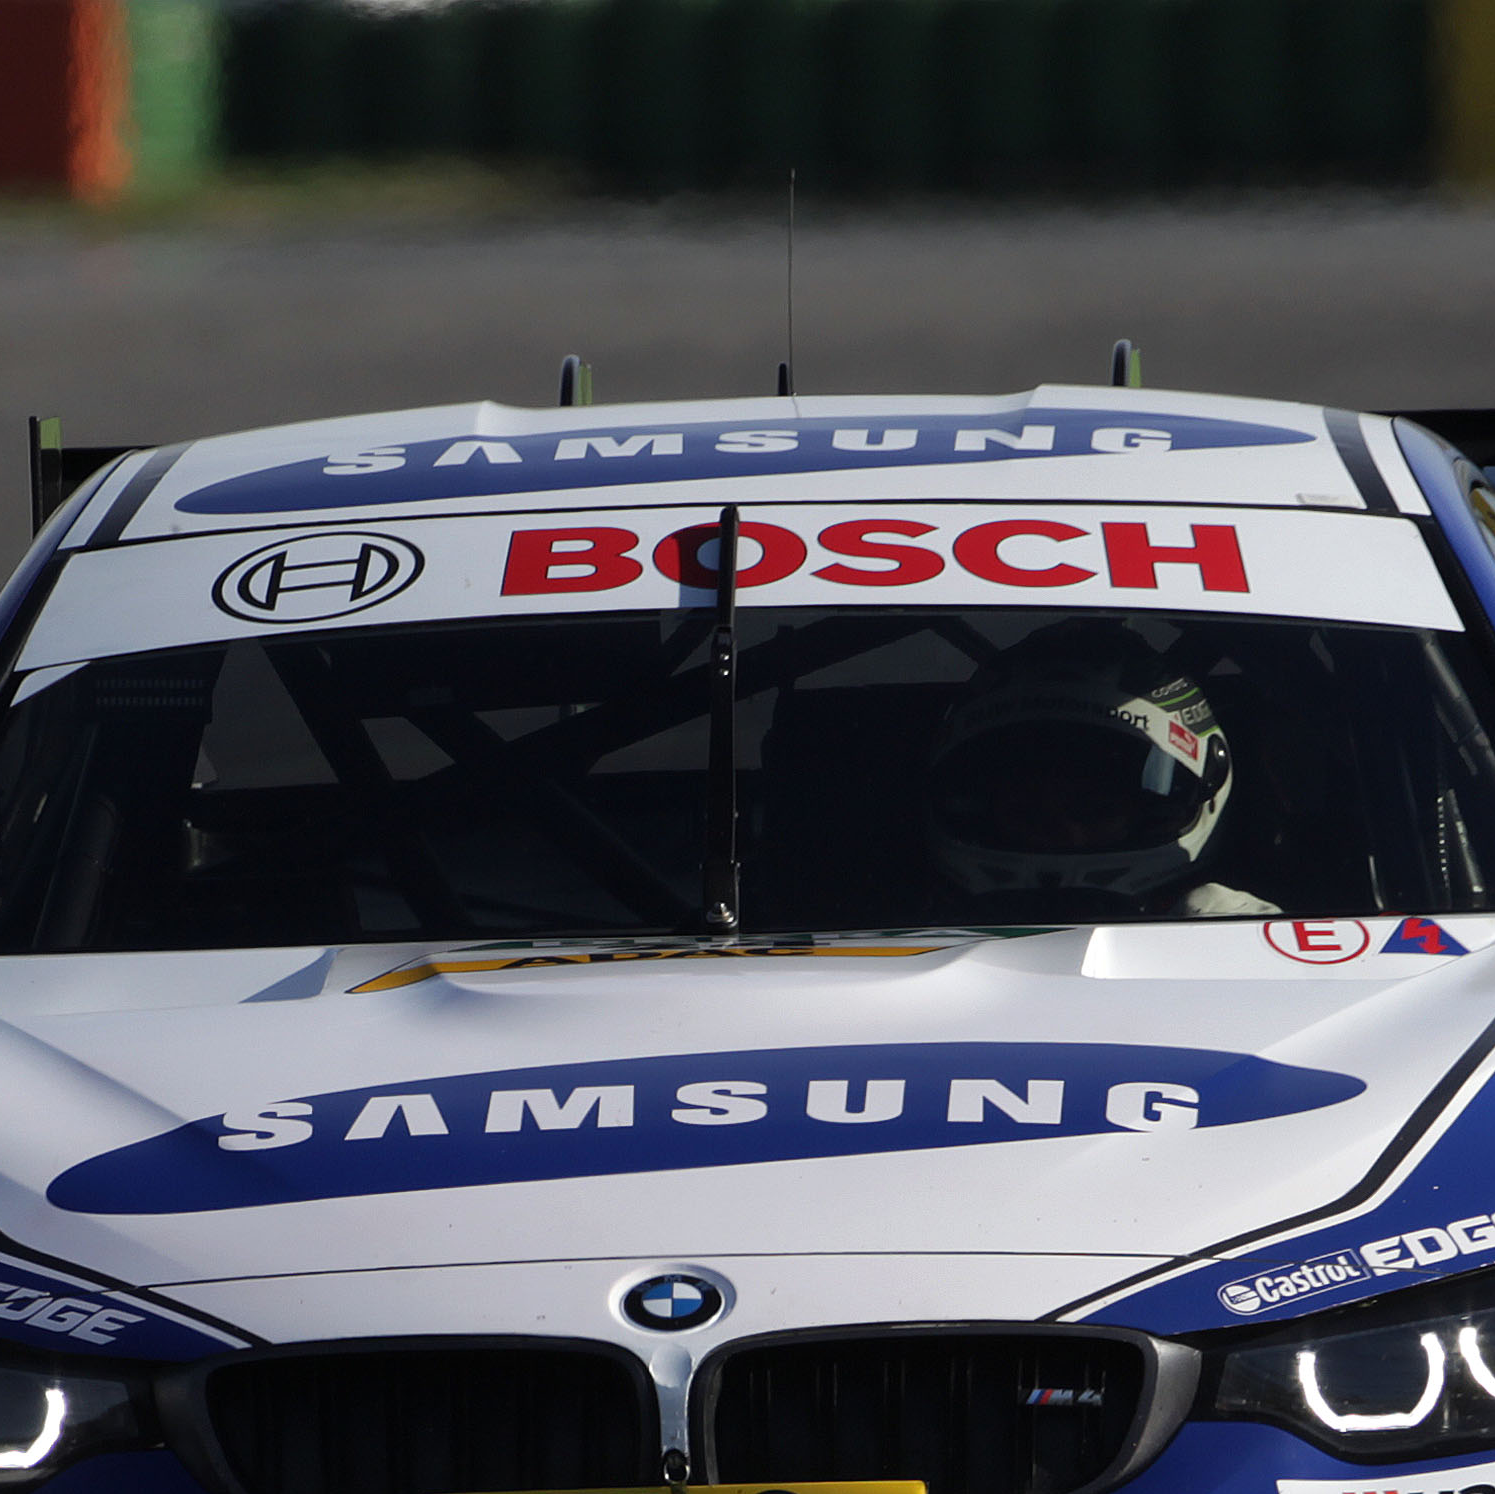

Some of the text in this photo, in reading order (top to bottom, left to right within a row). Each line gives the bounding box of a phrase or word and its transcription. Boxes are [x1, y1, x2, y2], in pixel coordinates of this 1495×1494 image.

[323, 423, 1173, 478] SAMSUNG
[499, 519, 1251, 597] BOSCH
[1292, 920, 1343, 952] E
[217, 1078, 1201, 1152] SAMSUNG
[1255, 1255, 1361, 1303] Castrol
